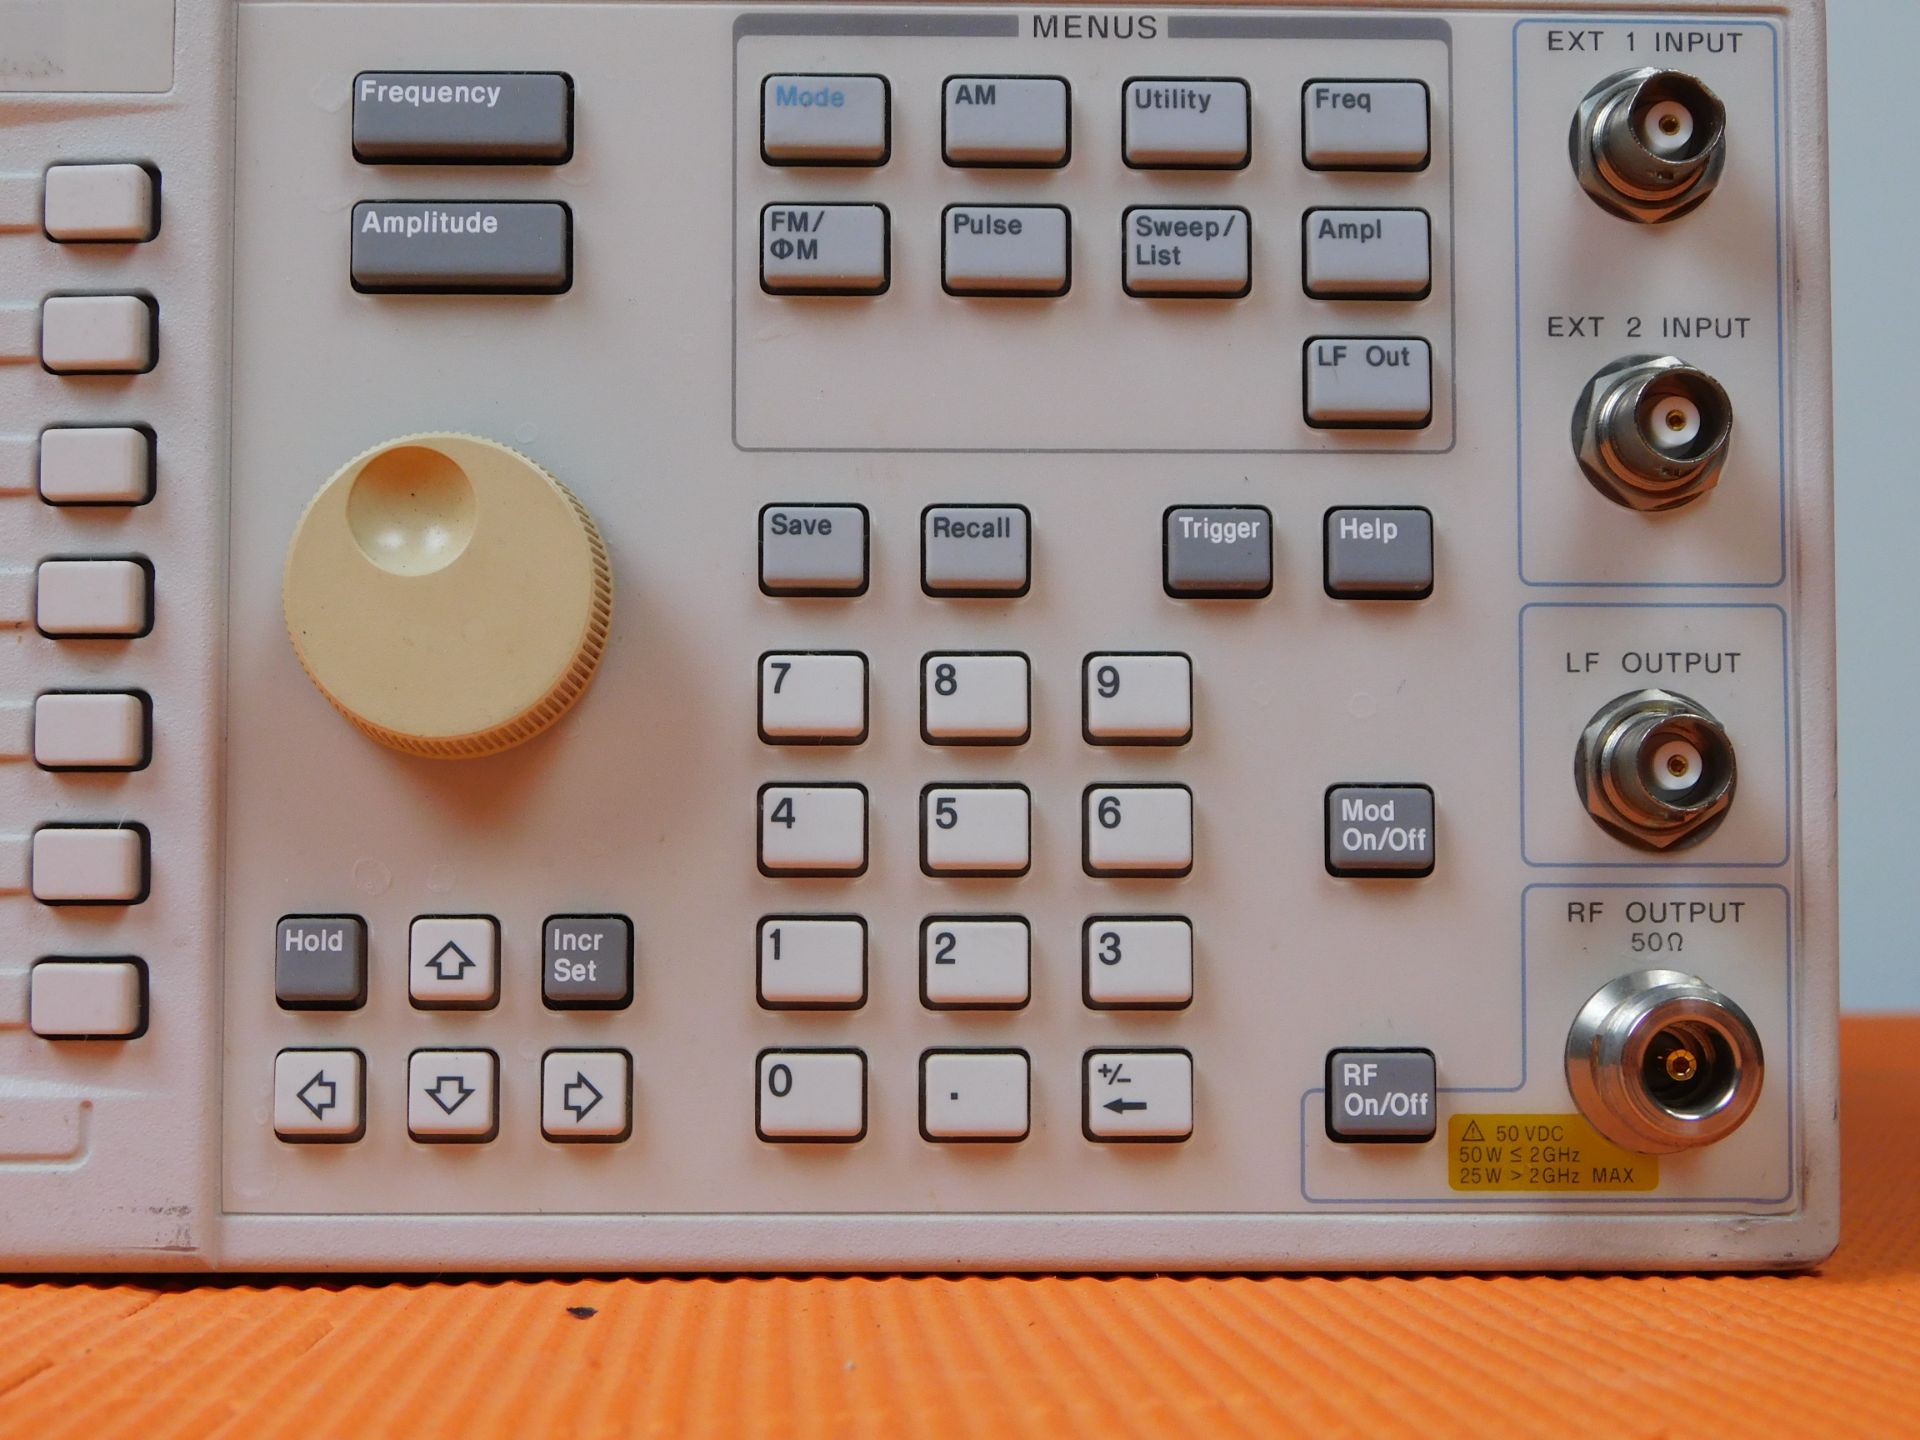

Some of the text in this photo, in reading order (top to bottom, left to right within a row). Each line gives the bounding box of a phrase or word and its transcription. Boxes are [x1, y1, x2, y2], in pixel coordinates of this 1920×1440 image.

[1032, 14, 1158, 39] MENUS
[1548, 31, 1743, 53] EXT 1 INPUT
[360, 79, 502, 108] Frequency
[776, 85, 846, 107] Mode
[954, 84, 996, 105] AM
[1134, 88, 1212, 113] Utility
[1315, 88, 1371, 112] Freq
[361, 210, 499, 237] Amplitude
[771, 211, 825, 232] FM/
[954, 213, 1022, 235] Pulse
[1136, 215, 1236, 243] Sweep/
[1318, 219, 1382, 243] Ampl
[1136, 245, 1181, 266] List
[1548, 317, 1751, 338] EXT 2 INPUT
[1318, 346, 1410, 367] LF Out
[771, 513, 832, 536] Save
[933, 517, 1011, 539] Recall
[1178, 516, 1260, 543] Trigger
[1339, 518, 1398, 544] Help
[1565, 652, 1741, 674] LF OUTPUT
[770, 662, 792, 694] 7
[934, 664, 957, 696] 8
[1097, 666, 1121, 698] 9
[770, 797, 796, 829] 4
[935, 797, 958, 829] 5
[1098, 796, 1122, 829] 6
[1342, 798, 1394, 821] Mod
[1342, 827, 1427, 851] On/Off
[1568, 902, 1745, 923] RF OUTPUT
[285, 929, 343, 952] Hold
[553, 928, 603, 951] Incr
[769, 928, 782, 960] 1
[935, 932, 957, 965] 2
[1098, 932, 1122, 965] 3
[553, 958, 597, 982] Set
[767, 1063, 793, 1098] 0
[1344, 1063, 1378, 1086] RF
[1344, 1092, 1428, 1117] On/Off
[1496, 1125, 1565, 1142] 50 VDC
[1592, 1167, 1635, 1184] MAX
